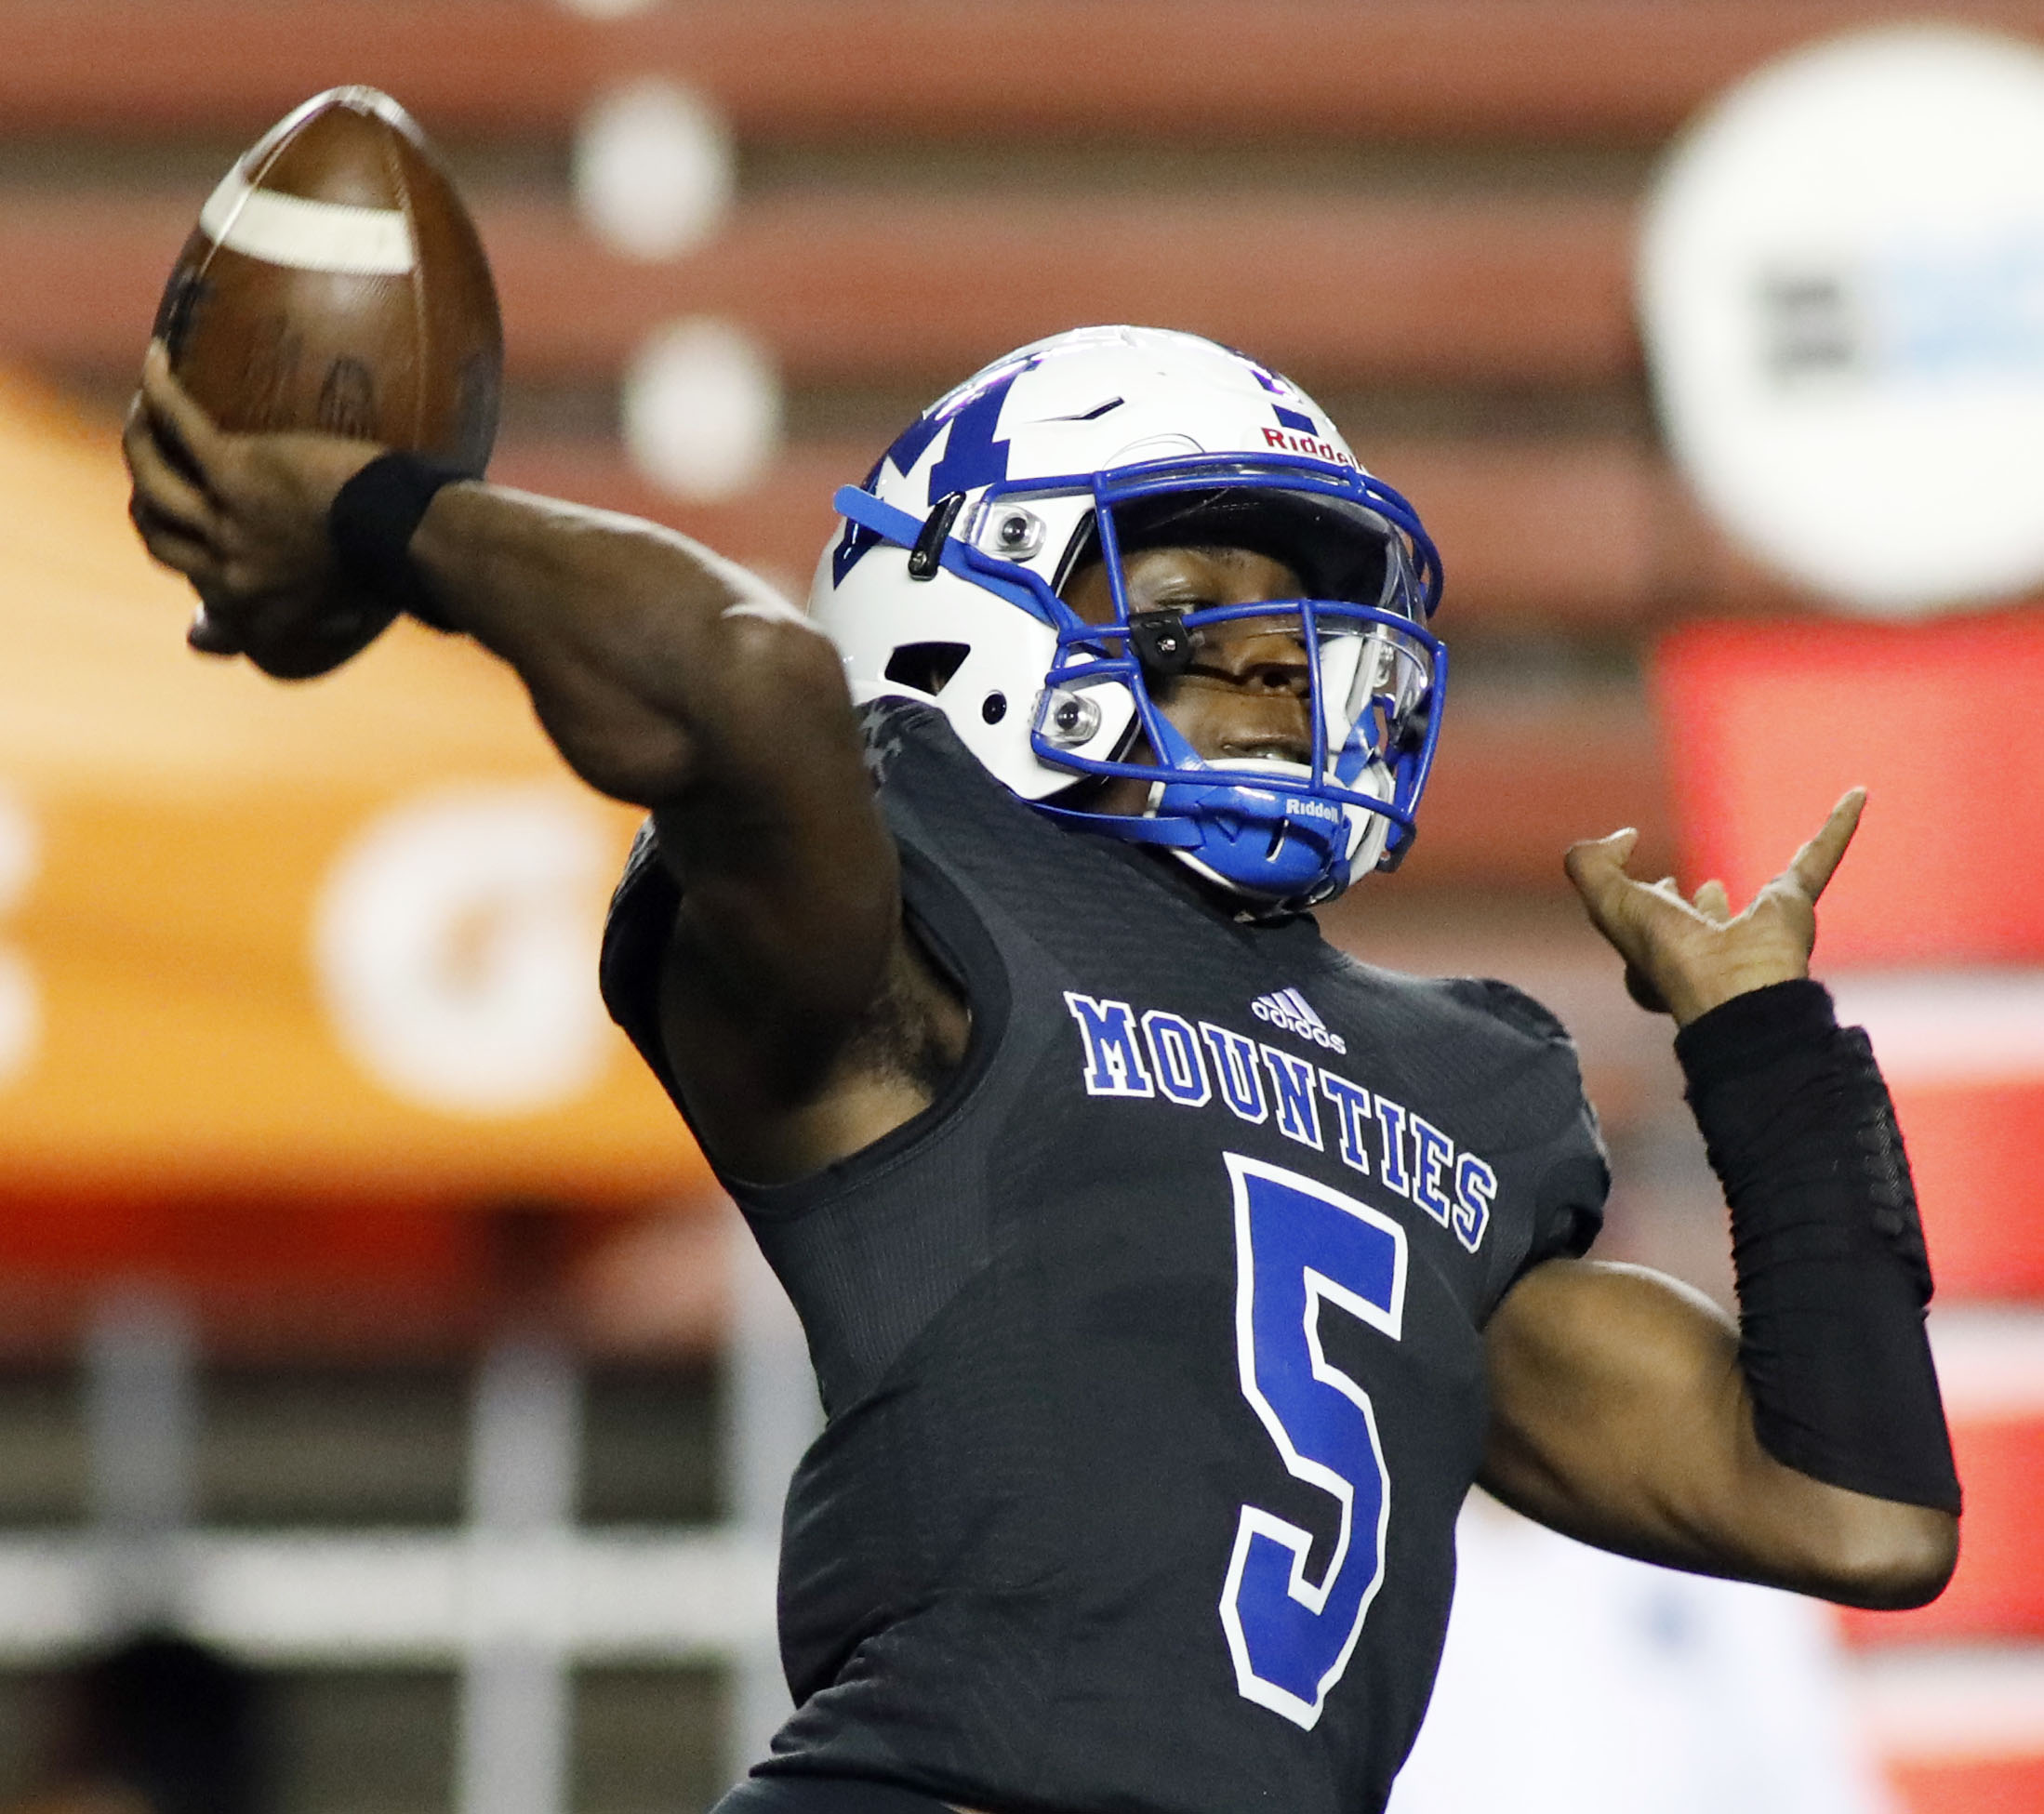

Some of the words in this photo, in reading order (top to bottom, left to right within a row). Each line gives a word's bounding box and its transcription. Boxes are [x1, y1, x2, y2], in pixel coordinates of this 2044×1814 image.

[1285, 798, 1340, 825] Riddell
[1250, 991, 1347, 1055] adidas
[1063, 990, 1497, 1254] MOUNTIES
[1218, 1150, 1409, 1732] 5
